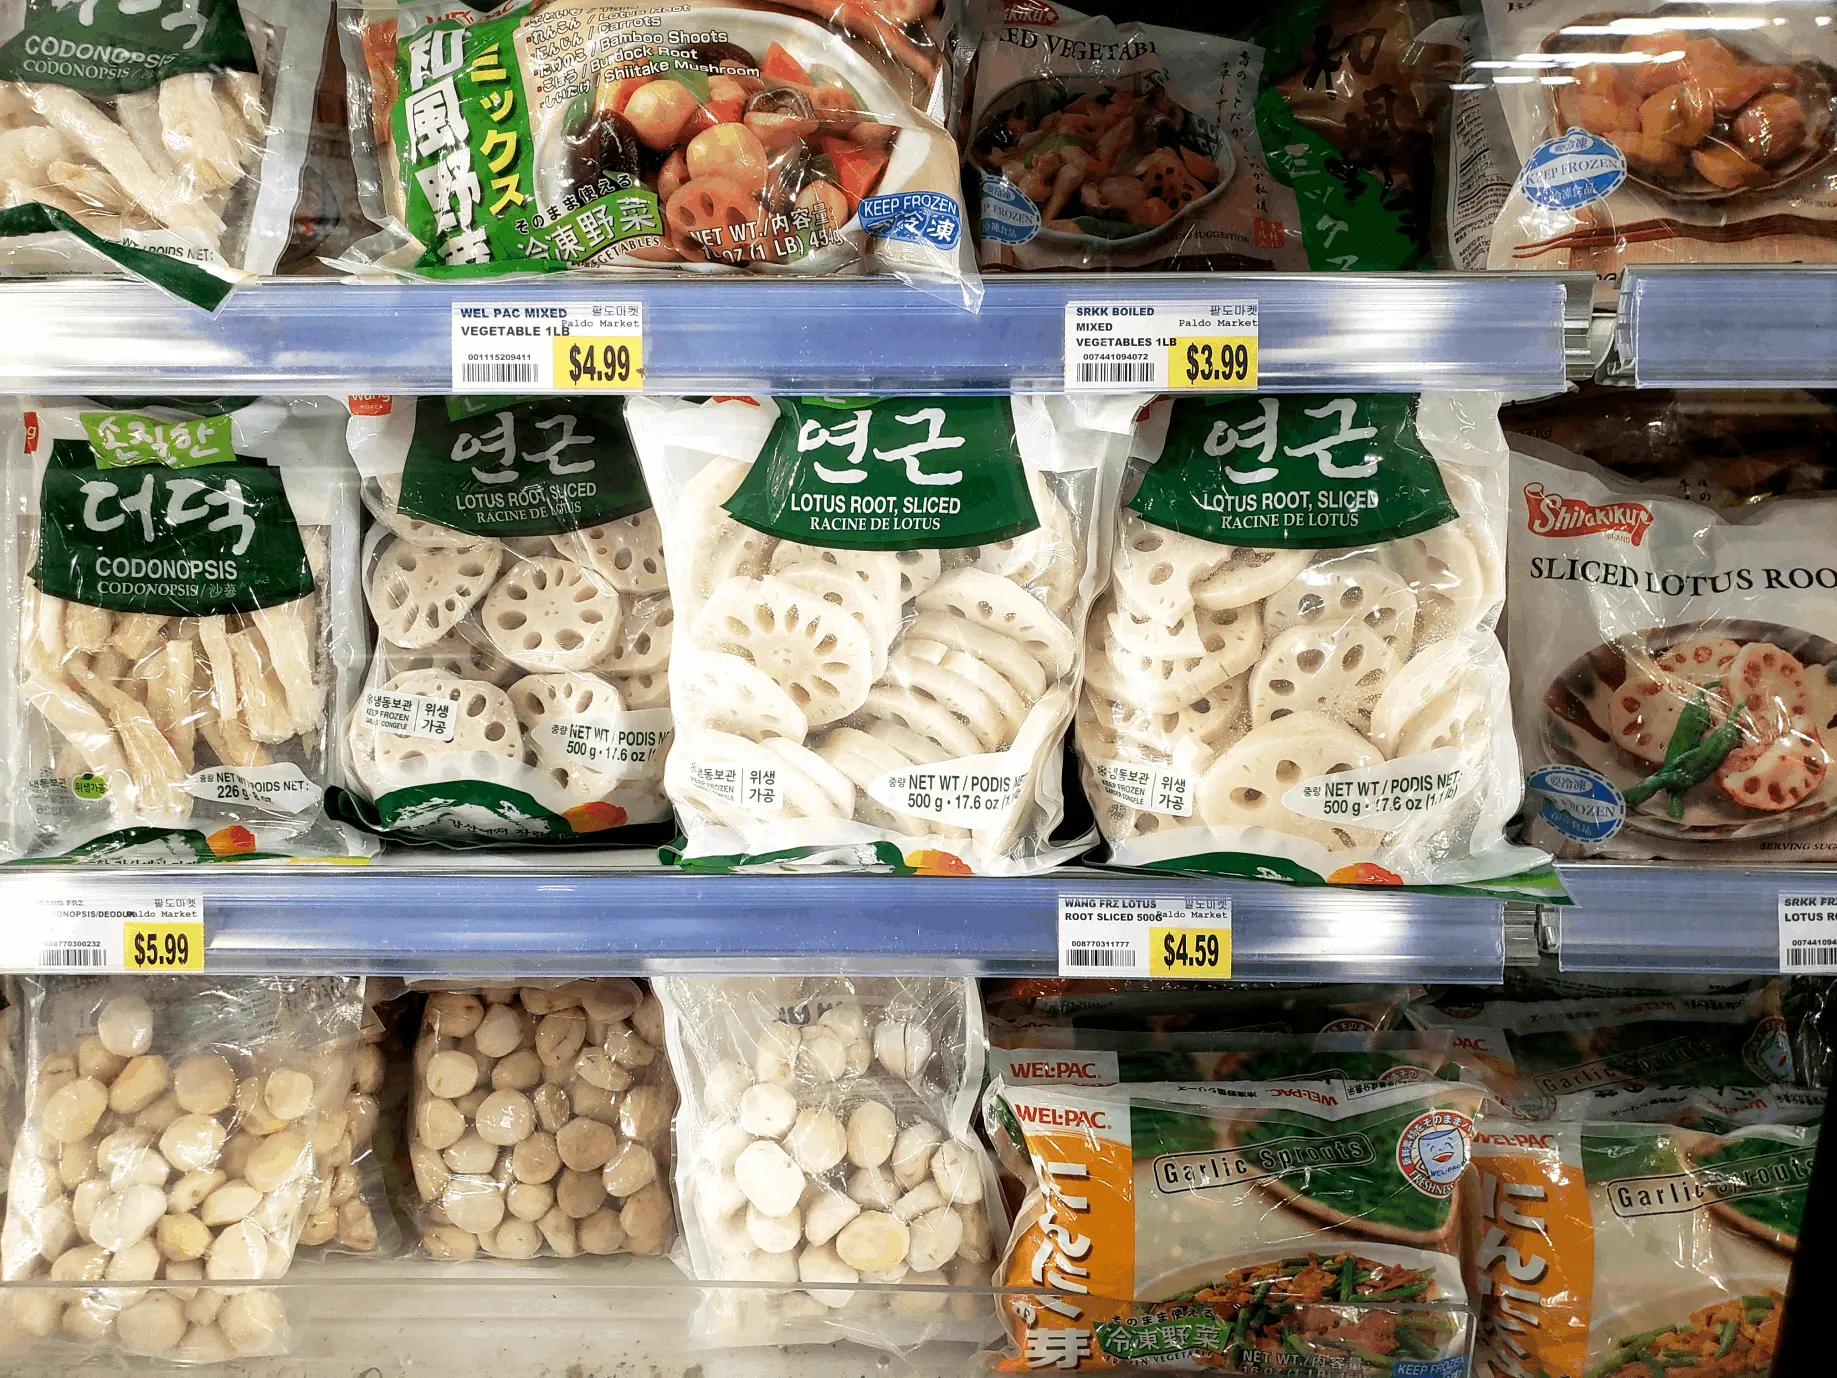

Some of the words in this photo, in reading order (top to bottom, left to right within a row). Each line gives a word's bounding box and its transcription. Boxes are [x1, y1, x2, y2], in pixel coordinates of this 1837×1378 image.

[532, 17, 581, 44] れんこん
[650, 4, 691, 14] Root
[597, 16, 662, 35] Carrots
[600, 29, 664, 51] Bamboo
[669, 30, 728, 44] Shoots
[24, 35, 179, 68] CODONOPSIS
[591, 46, 654, 73] Burdock
[658, 46, 699, 59] Root
[23, 59, 130, 80] CODONOPSIS
[604, 60, 670, 84] Shiitake
[674, 60, 761, 78] Mushroom
[471, 43, 523, 215] ミックス
[1526, 167, 1558, 185] KEEP
[1561, 159, 1618, 176] FROZEN
[515, 173, 633, 235] そのまま使える
[864, 198, 900, 218] KEEP
[903, 194, 957, 216] FROZEN
[517, 197, 657, 260] 冷凍野菜
[690, 228, 723, 246] NET
[773, 236, 805, 256] LB)
[809, 227, 845, 249] 454g
[460, 308, 489, 319] WEL
[493, 308, 521, 318] PAC
[524, 308, 568, 318] MIXED
[592, 305, 639, 317] 팔도마켓
[1076, 307, 1109, 317] SRKK
[1112, 307, 1155, 317] BOILED
[1209, 305, 1258, 316] 팔도마켓
[461, 326, 541, 336] VEGETABLE
[545, 326, 570, 337] 1LB
[561, 319, 594, 328] Paldo
[599, 319, 640, 328] Market
[1076, 322, 1113, 332] MIXED
[1178, 319, 1212, 327] Paldo
[1217, 319, 1259, 327] Market
[1076, 338, 1152, 347] VEGETABLES
[1155, 337, 1178, 347] 1LB
[467, 353, 531, 361] 001115209411
[569, 343, 631, 386] $4.99
[1083, 353, 1149, 361] 007441094072
[1186, 342, 1249, 385] $3.99
[450, 411, 596, 485] 연근
[797, 407, 966, 486] 연근
[1203, 397, 1379, 485] 연근
[456, 493, 506, 511] LOTUS
[549, 482, 598, 500] SLICED
[791, 493, 846, 514] LOTUS
[849, 495, 899, 516] ROOT,
[902, 496, 961, 515] SLICED
[1202, 491, 1258, 512] LOTUS
[1261, 491, 1314, 514] ROOT,
[1317, 488, 1379, 510] SLICED
[79, 473, 257, 556] 더덕
[476, 509, 530, 524] RACINE
[531, 508, 549, 520] DE
[550, 500, 582, 518] LOTUS
[1220, 513, 1281, 530] RACINE
[1283, 513, 1306, 527] DE
[1308, 512, 1360, 528] LOTUS
[1534, 495, 1650, 534] Shirakiku
[809, 516, 868, 531] RACINE
[870, 517, 890, 531] DE
[892, 517, 941, 531] LOTUS
[1606, 533, 1631, 544] BRAND
[96, 556, 238, 580] CODONOPSIS
[1530, 556, 1639, 589] SLICED
[1645, 567, 1755, 597] LOTUS
[1761, 566, 1837, 591] ROO
[97, 580, 198, 597] CODONOPSIS
[374, 695, 413, 712] 냉동보관
[424, 702, 449, 719] 위생
[366, 708, 379, 717] KEEP
[379, 710, 410, 722] FROZEN
[421, 719, 447, 735] 가공
[551, 724, 568, 736] 중량
[569, 723, 592, 740] NET
[594, 726, 610, 744] WT
[618, 731, 657, 747] PODIS
[566, 740, 588, 756] 500
[589, 746, 597, 761] g
[630, 751, 646, 762] oz
[200, 774, 215, 783] 중량
[216, 772, 236, 783] NET
[250, 781, 281, 793] POIDS
[749, 769, 776, 786] 위생
[888, 776, 907, 788] 중량
[908, 774, 936, 790] NET
[939, 774, 960, 791] WT
[971, 776, 1011, 793] PODIS
[1161, 776, 1186, 794] 위생
[1324, 782, 1354, 798] NET
[1357, 780, 1380, 797] WT
[1390, 774, 1433, 795] PODIS
[217, 784, 240, 799] 226
[242, 788, 250, 801] g
[749, 787, 776, 804] 가공
[1116, 783, 1146, 797] FROZEN
[1302, 786, 1322, 798] 중량
[907, 793, 931, 809] 500
[934, 797, 943, 812] g
[955, 794, 981, 810] 17.6
[984, 798, 999, 810] oz
[1158, 793, 1185, 811] 가공
[1323, 799, 1349, 815] 500
[1352, 801, 1362, 817] g
[1405, 797, 1422, 811] oz
[1760, 841, 1811, 851] SERVING
[153, 898, 197, 908] 팔도마켓
[1065, 899, 1097, 909] WANG
[1099, 899, 1120, 909] FRZ
[1122, 899, 1157, 909] LOTUS
[1784, 897, 1817, 907] SRKK
[161, 910, 198, 918] Market
[1065, 912, 1094, 922] ROOT
[1096, 912, 1134, 922] SLICED
[1136, 912, 1163, 922] 500G
[1156, 910, 1187, 919] Paldo
[1191, 910, 1228, 919] Market
[1784, 912, 1824, 922] LOTUS
[134, 931, 189, 968] $5.99
[1163, 931, 1220, 970] $4.59
[1542, 1066, 1617, 1093] Garlic
[1621, 1038, 1713, 1074] Sprouts
[1163, 1157, 1248, 1185] Garlic
[1258, 1138, 1363, 1171] Sprouts
[1410, 1169, 1455, 1196] FRESHNESS
[1617, 1182, 1706, 1210] Garlic
[1112, 1307, 1213, 1327] そのまま使える
[1104, 1323, 1222, 1353] 冷凍野菜
[1242, 1350, 1271, 1364] NET
[1397, 1364, 1428, 1376] KEEP
[1429, 1355, 1465, 1374] FROZEN
